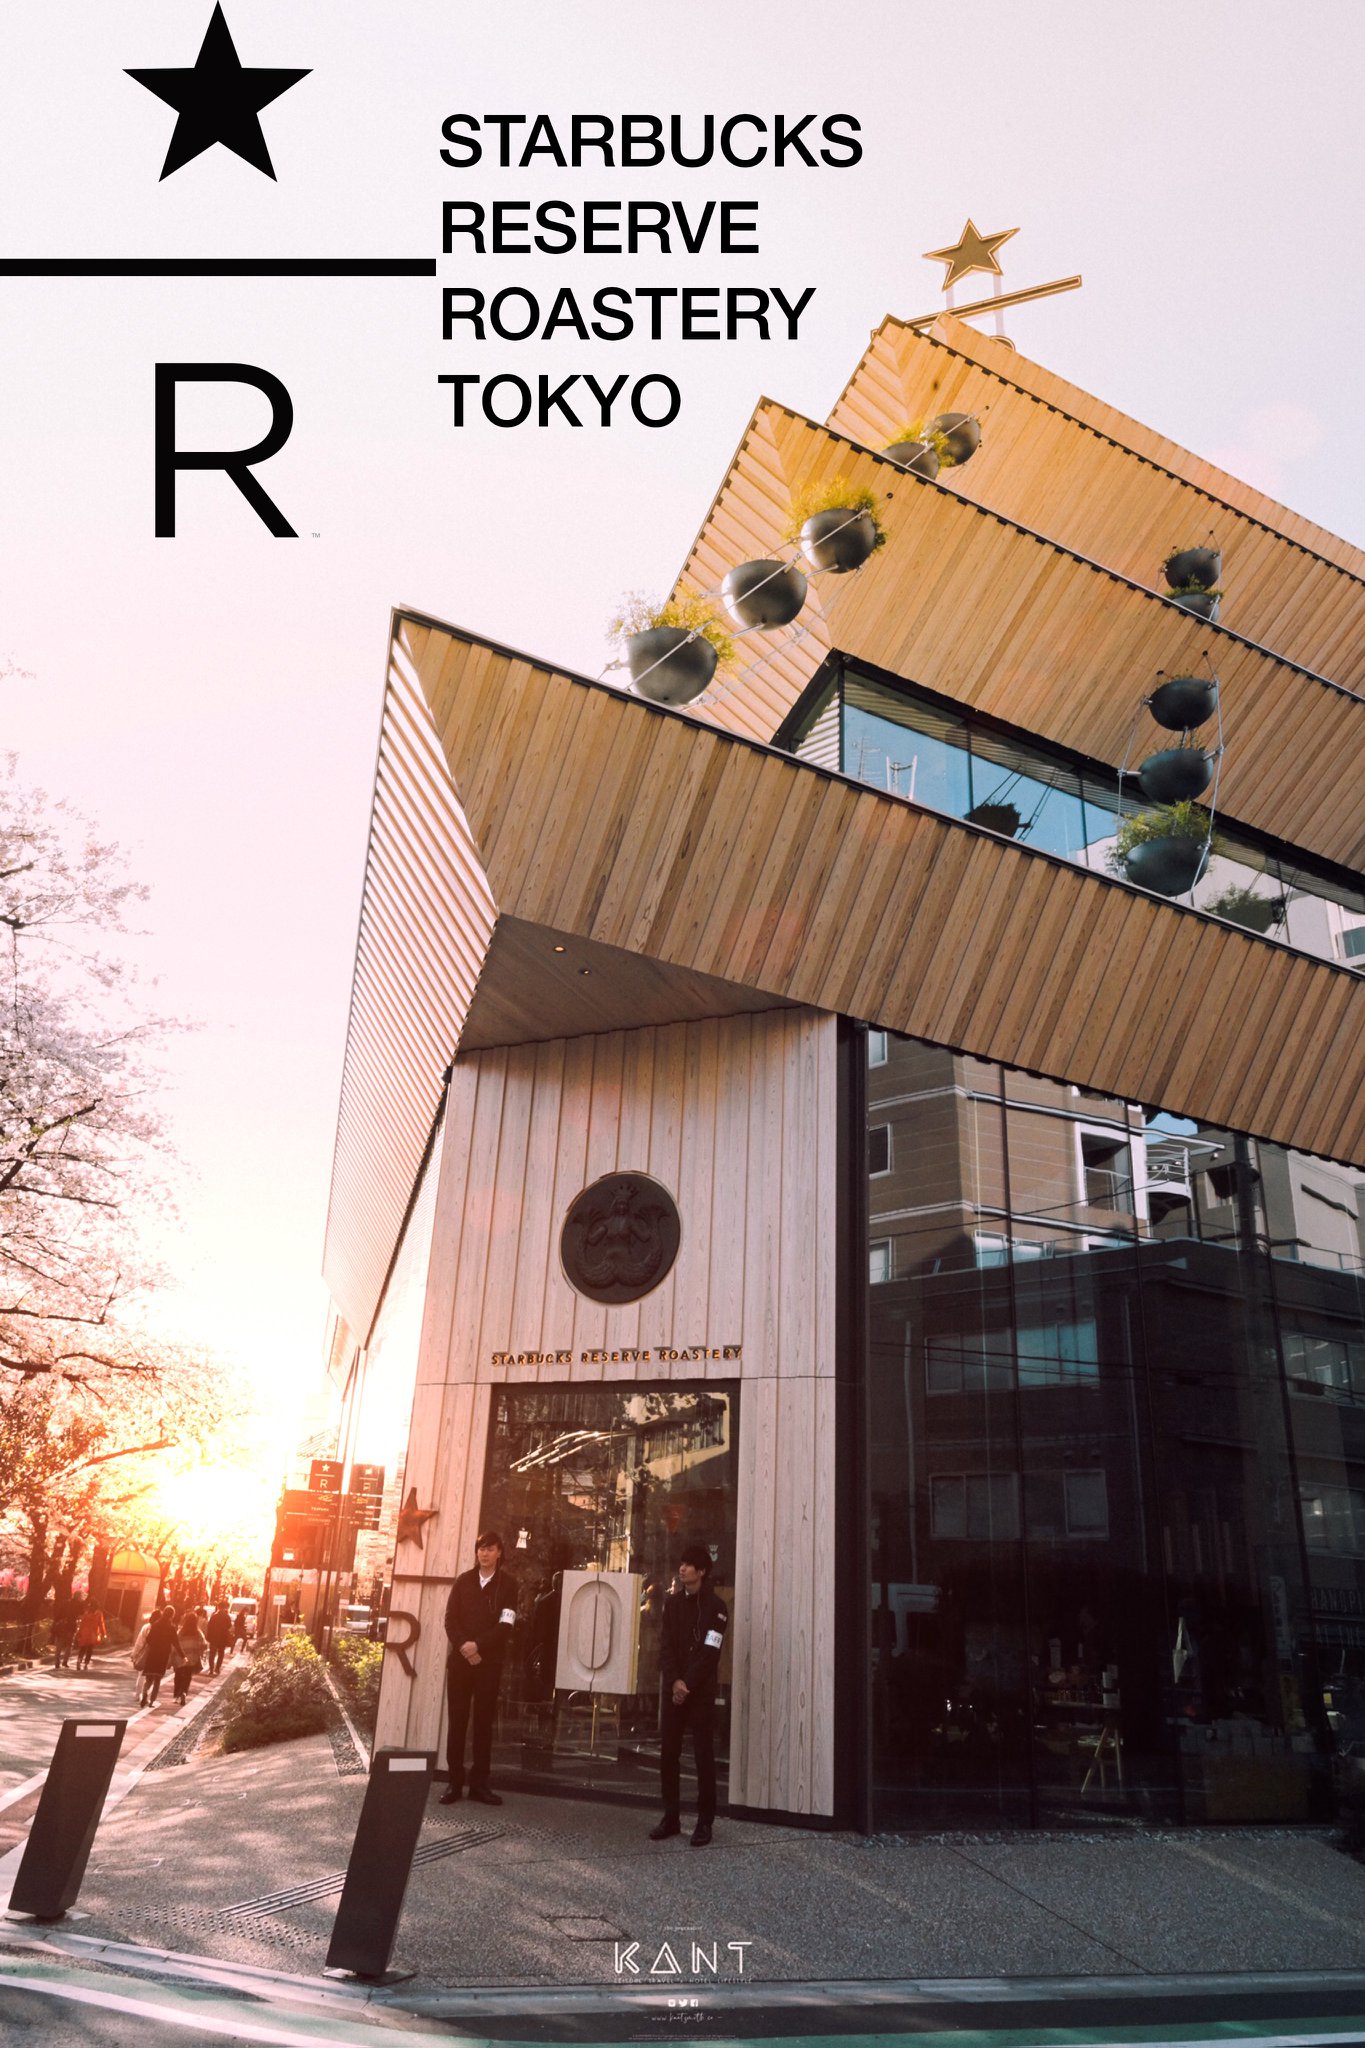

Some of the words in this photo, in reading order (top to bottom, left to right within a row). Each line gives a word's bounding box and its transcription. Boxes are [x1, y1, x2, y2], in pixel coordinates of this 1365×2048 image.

[491, 1351, 573, 1365] STARBUCKS
[580, 1349, 651, 1364] RESERVE
[658, 1347, 743, 1361] ROASTERY
[319, 1479, 328, 1488] R
[386, 1610, 421, 1678] R
